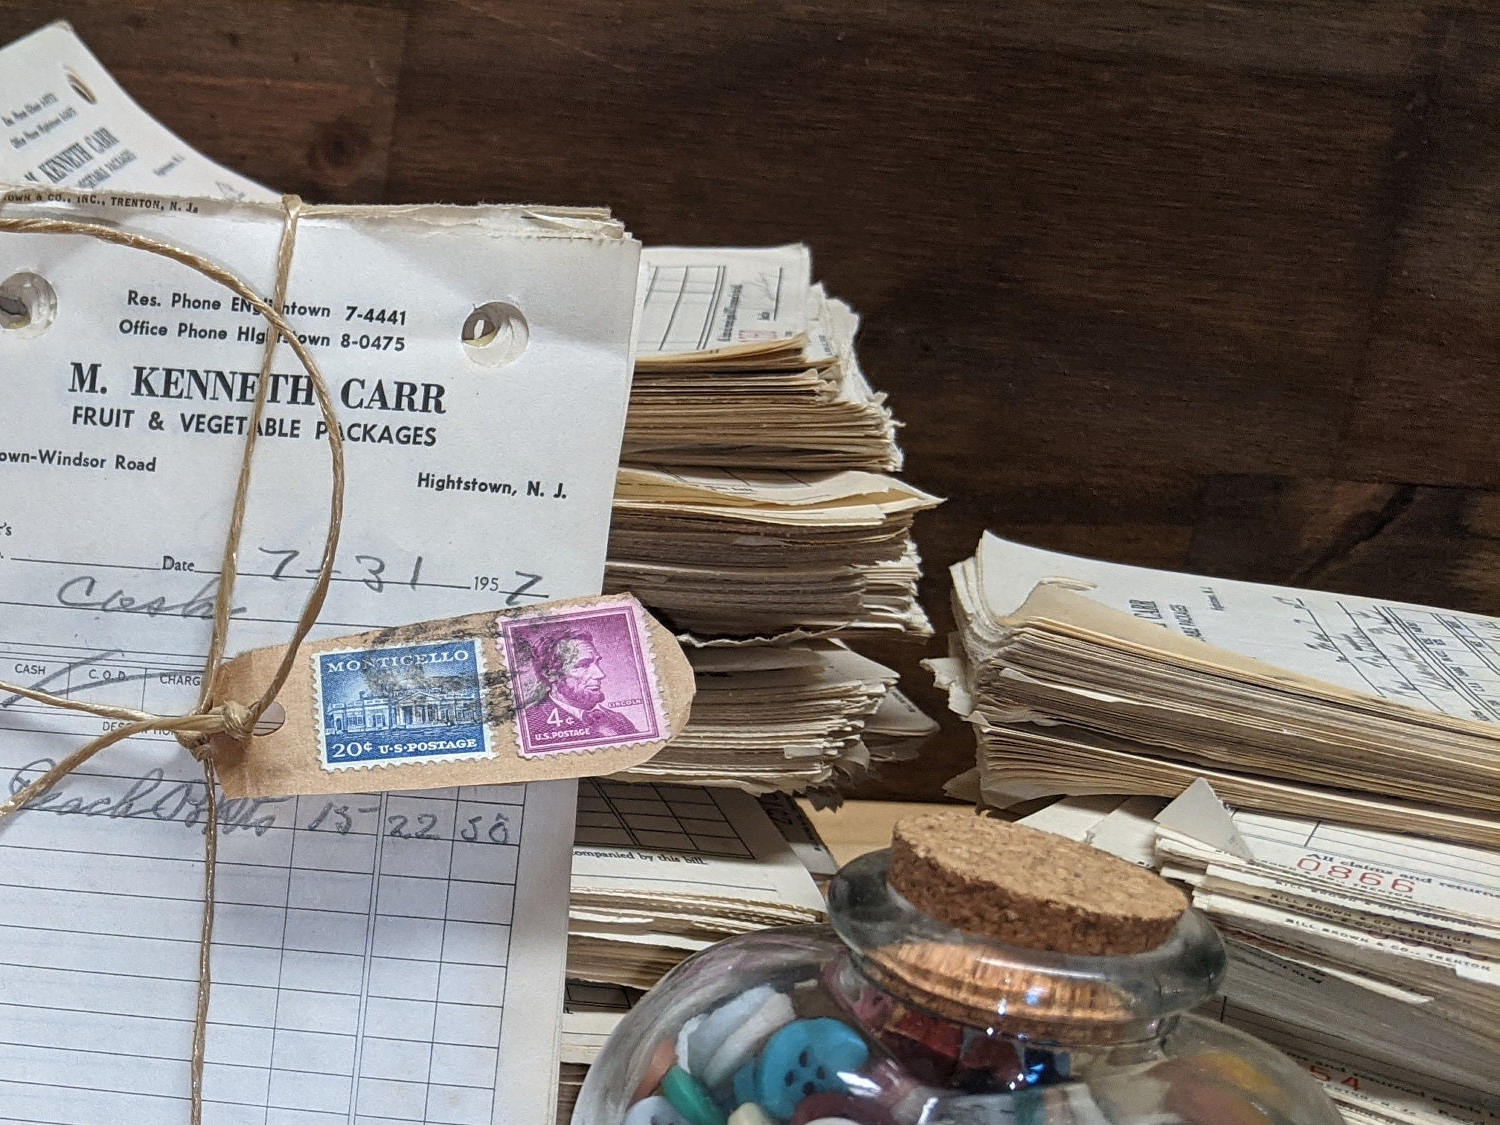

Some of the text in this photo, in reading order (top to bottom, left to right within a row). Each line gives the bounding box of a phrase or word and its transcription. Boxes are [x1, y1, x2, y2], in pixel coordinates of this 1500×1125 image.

[84, 127, 120, 153] CARR
[127, 290, 407, 326] Res. Phone 7-4441
[119, 319, 405, 352] Office Phone 8-0475
[68, 361, 447, 414] M. KENNETH CARR
[72, 406, 134, 428] FRUIT
[148, 412, 164, 431] &
[315, 421, 437, 447] PCKAGES
[115, 454, 156, 473] Road
[417, 473, 567, 499] Hightstown, N. J.
[162, 555, 194, 572] Date
[473, 576, 499, 592] 195
[327, 650, 469, 673] MONTICELLO
[14, 663, 46, 676] CASH
[159, 673, 201, 687] CHARG
[607, 699, 642, 709] LINCOLN
[638, 852, 681, 863] by this
[1306, 853, 1334, 863] All
[1339, 859, 1394, 876] claims
[1399, 872, 1432, 884] and
[1297, 857, 1416, 893] 0866
